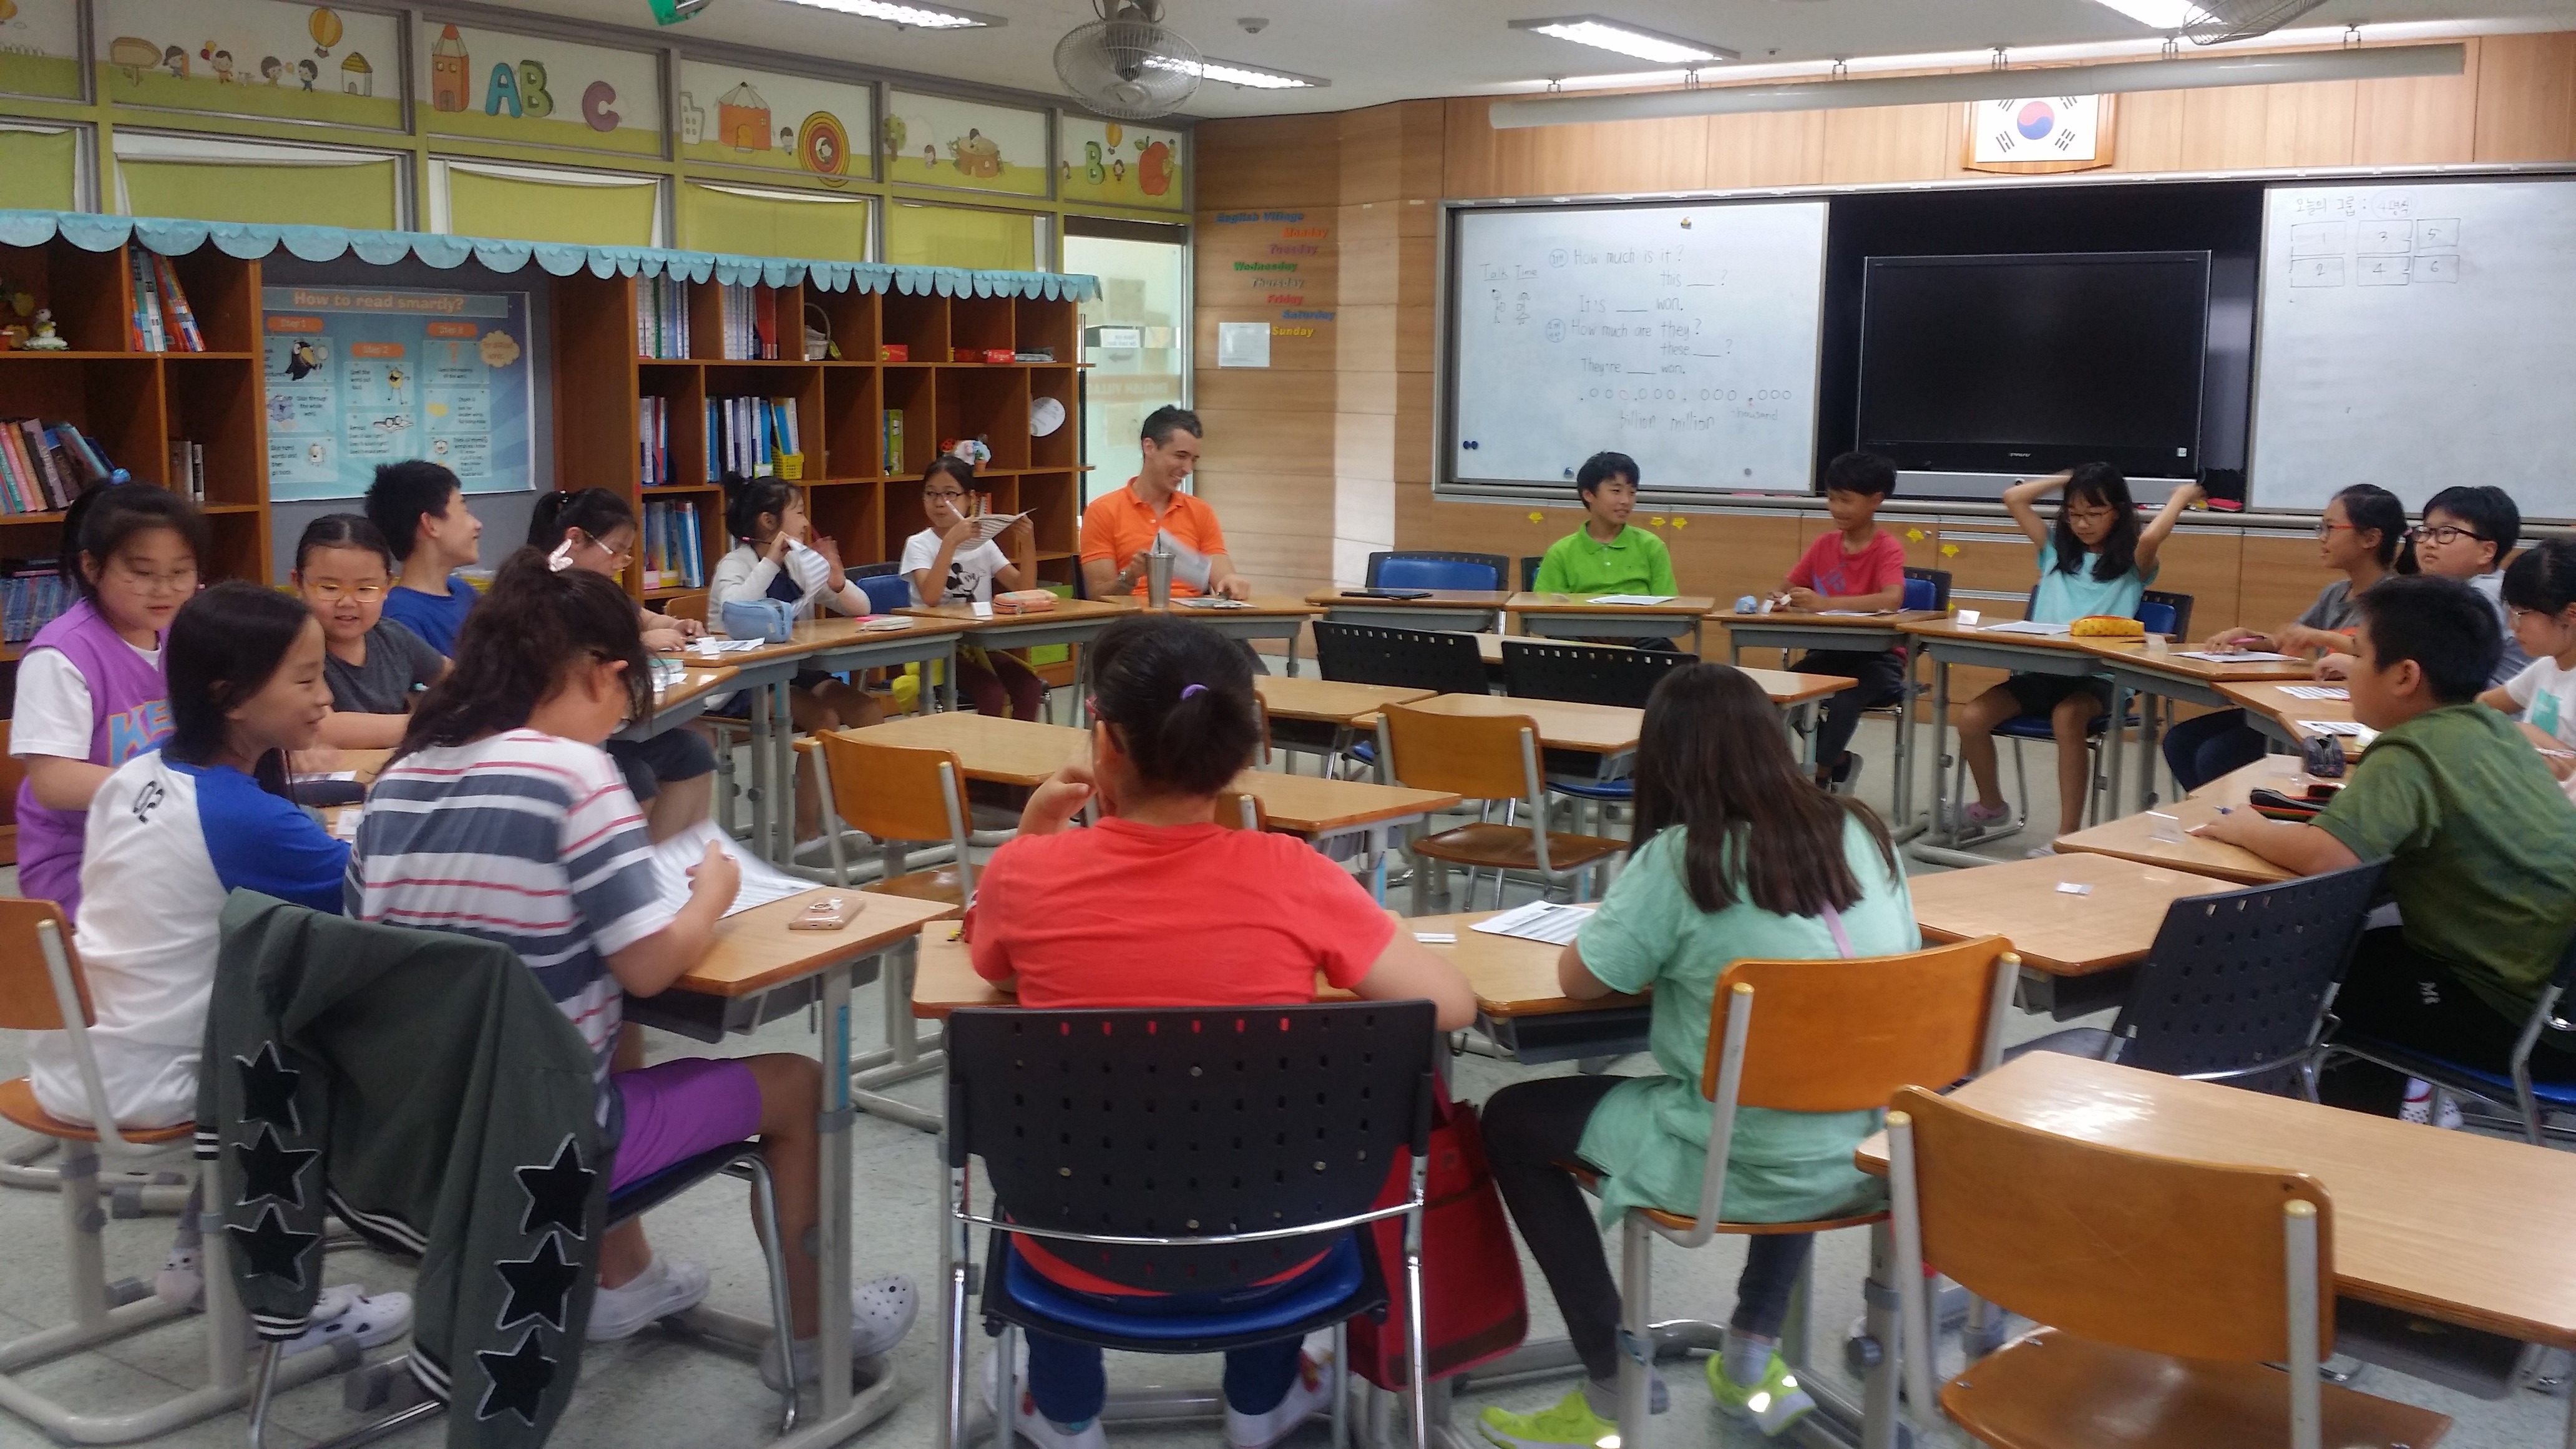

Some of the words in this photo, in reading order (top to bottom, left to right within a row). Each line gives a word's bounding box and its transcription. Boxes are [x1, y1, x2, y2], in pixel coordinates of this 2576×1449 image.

[1217, 213, 1259, 223] English
[1264, 213, 1304, 222] Village
[1283, 228, 1327, 238] Monday
[2378, 231, 2389, 243] 3
[2428, 228, 2442, 240] 5
[1271, 244, 1317, 255] Tuesday
[1574, 249, 1598, 265] How
[1606, 247, 1635, 264] much
[1644, 249, 1653, 263] is
[1234, 262, 1297, 271] Wednesday
[1479, 263, 1508, 278] Talk
[1515, 265, 1538, 279] Time
[2316, 263, 2326, 276] 2
[2372, 263, 2386, 280] 4
[2431, 261, 2439, 273] 6
[1253, 278, 1304, 288] Thursday
[1660, 269, 1682, 287] this
[294, 290, 329, 306] How
[334, 294, 351, 306] to
[355, 294, 393, 308] read
[1267, 295, 1303, 305] Friday
[1579, 295, 1606, 313] It's
[1282, 311, 1335, 321] Saturday
[1272, 326, 1314, 338] Sunday
[1571, 318, 1597, 336] How
[1602, 323, 1627, 338] much
[1634, 326, 1652, 337] are
[1659, 341, 1690, 357] these
